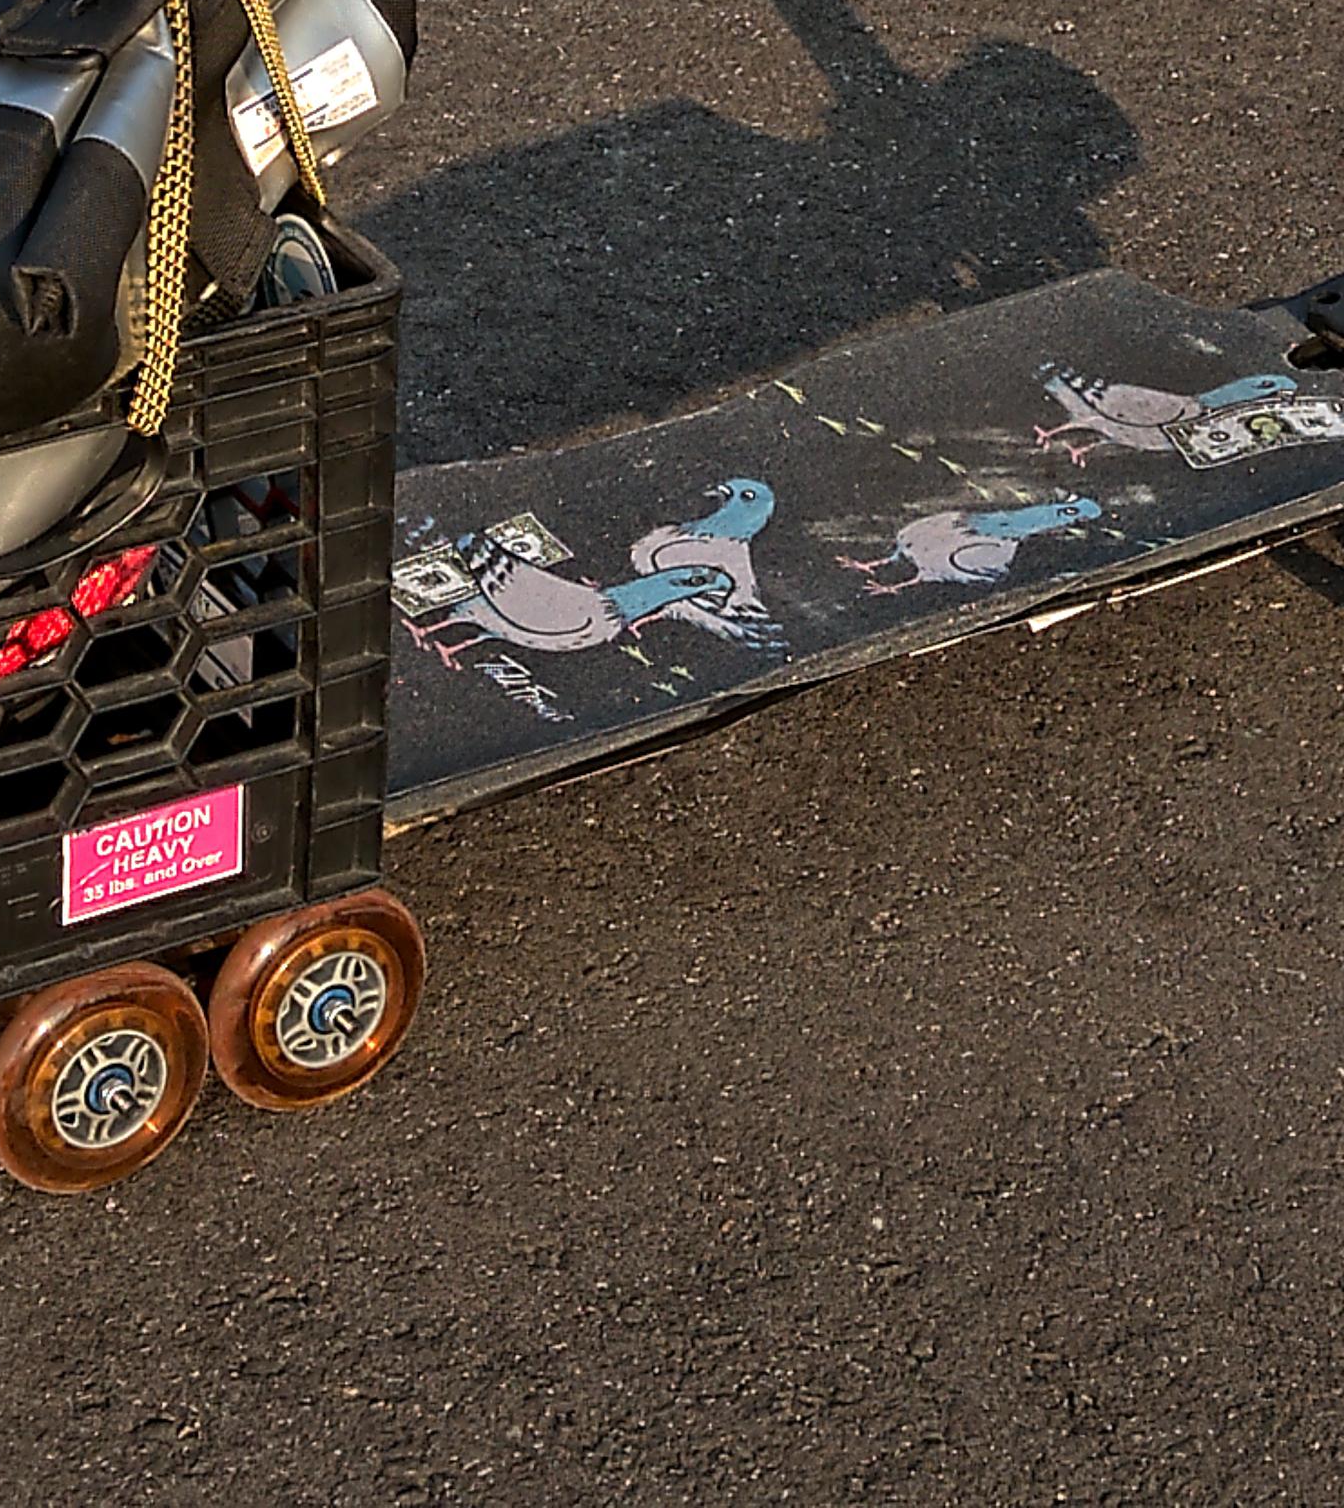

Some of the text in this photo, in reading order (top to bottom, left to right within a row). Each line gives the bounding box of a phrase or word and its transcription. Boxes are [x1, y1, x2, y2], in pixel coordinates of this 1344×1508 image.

[96, 805, 212, 857] CAUTION
[112, 834, 195, 876] HEAVY
[82, 885, 105, 904] 35
[143, 863, 178, 885] and
[181, 851, 224, 874] Over
